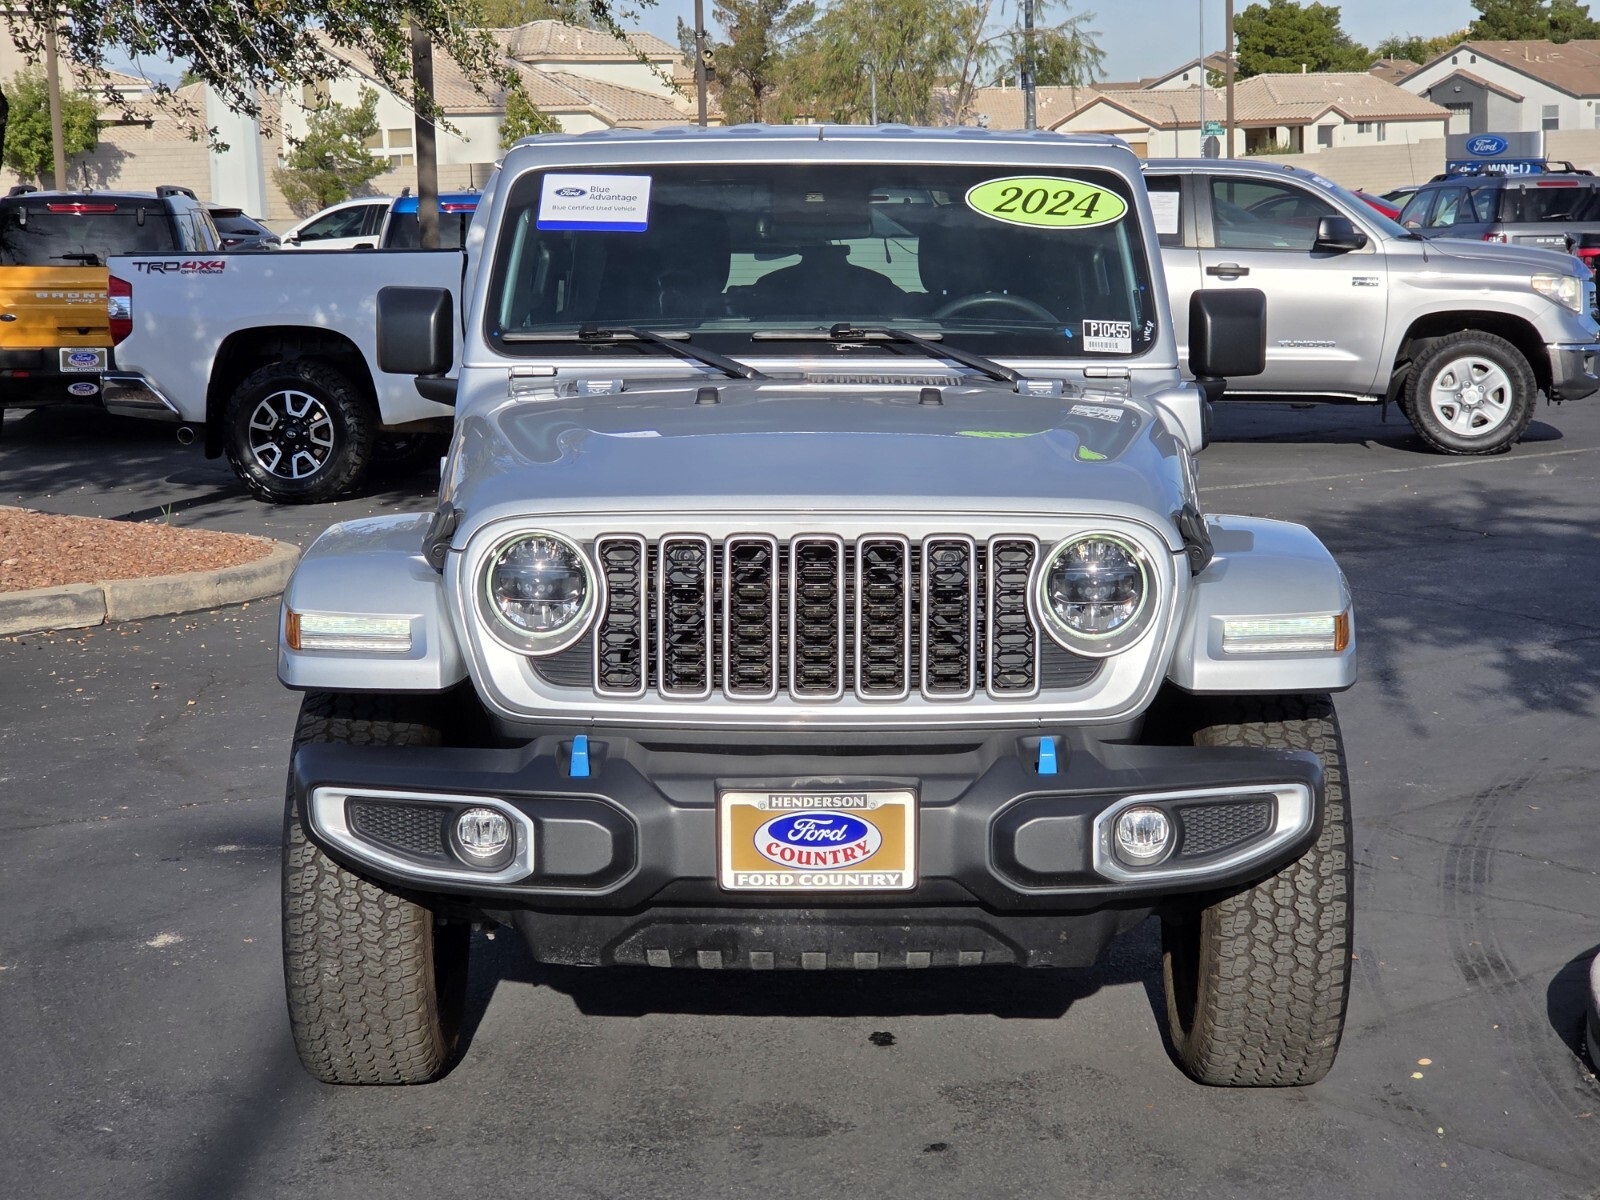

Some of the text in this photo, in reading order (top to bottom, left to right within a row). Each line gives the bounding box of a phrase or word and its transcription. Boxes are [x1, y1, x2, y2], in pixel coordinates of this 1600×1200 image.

[1473, 138, 1498, 152] Ford
[560, 188, 582, 197] Ford
[590, 185, 610, 193] Blue
[589, 193, 637, 202] Advantage
[993, 186, 1101, 218] 2024
[552, 204, 567, 212] Blue
[568, 204, 594, 212] Certified
[132, 261, 180, 274] TRD
[35, 291, 108, 299] BRONC
[1090, 322, 1129, 337] P10455
[769, 796, 865, 808] HENDERSON
[787, 818, 848, 841] Ford
[765, 840, 871, 866] COUNTRY
[737, 874, 899, 886] FORD COUNTRY
